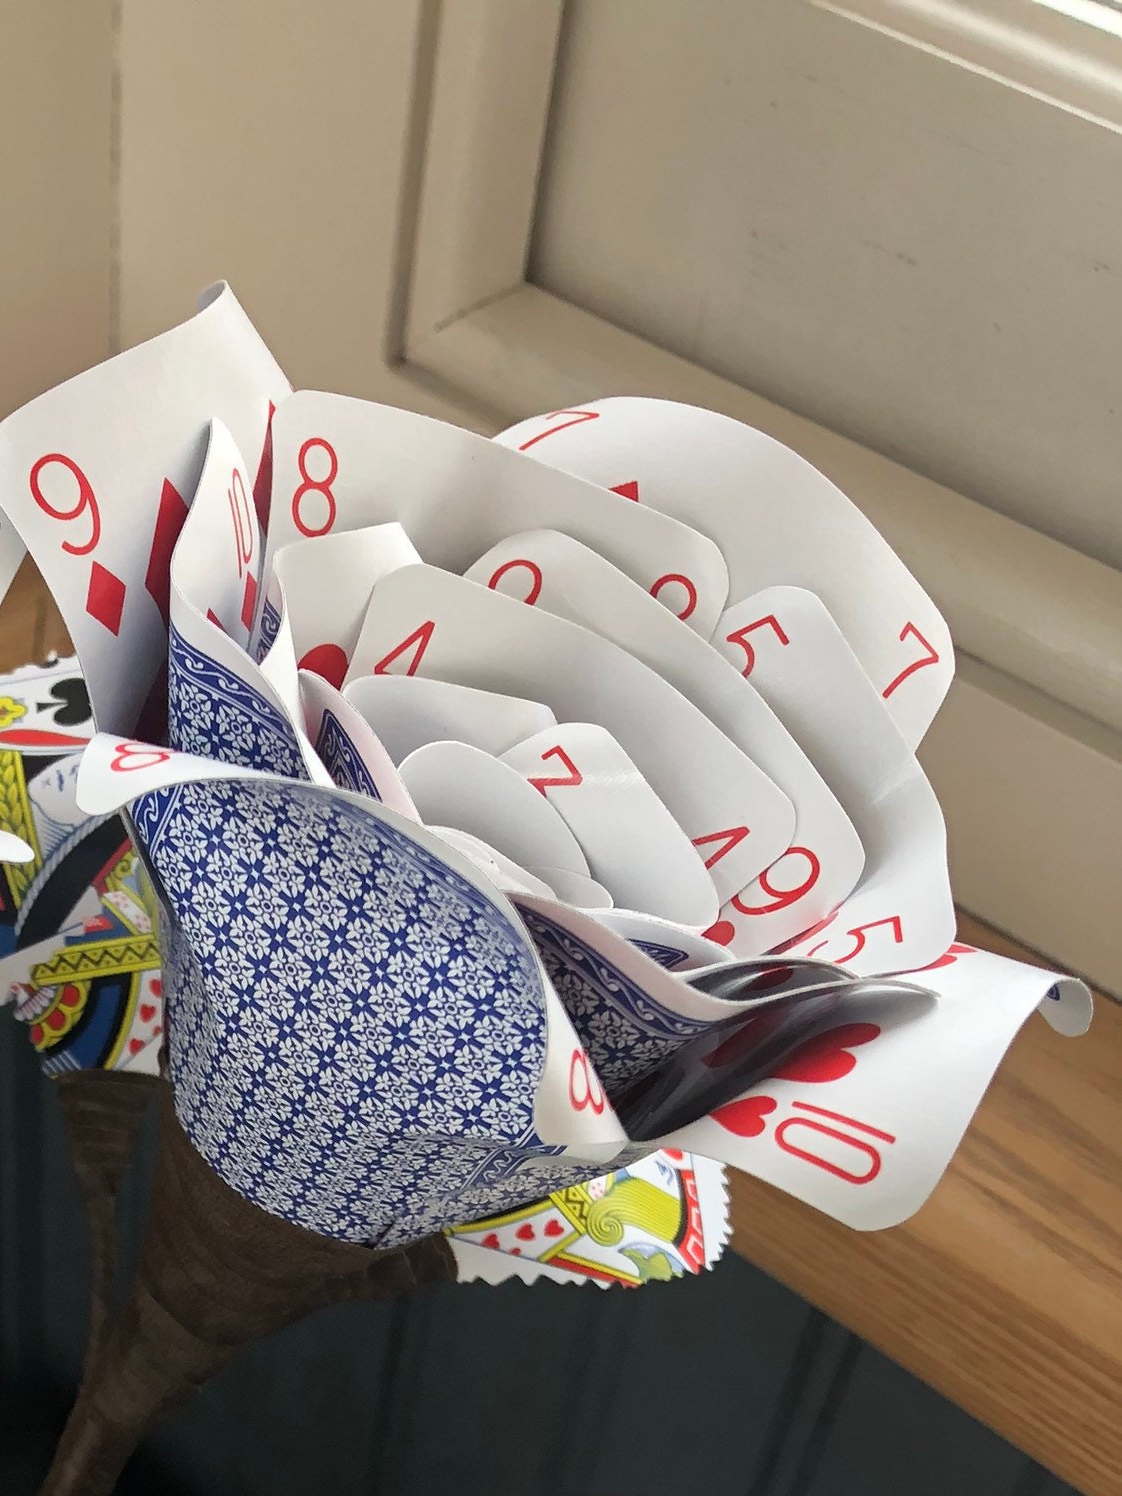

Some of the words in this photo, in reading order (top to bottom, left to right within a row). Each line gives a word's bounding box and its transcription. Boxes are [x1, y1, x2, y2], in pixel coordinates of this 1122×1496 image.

[520, 409, 599, 450] 7
[30, 453, 101, 556] 9
[291, 437, 338, 538] 8
[882, 622, 939, 699] 7
[775, 1098, 896, 1185] 10
